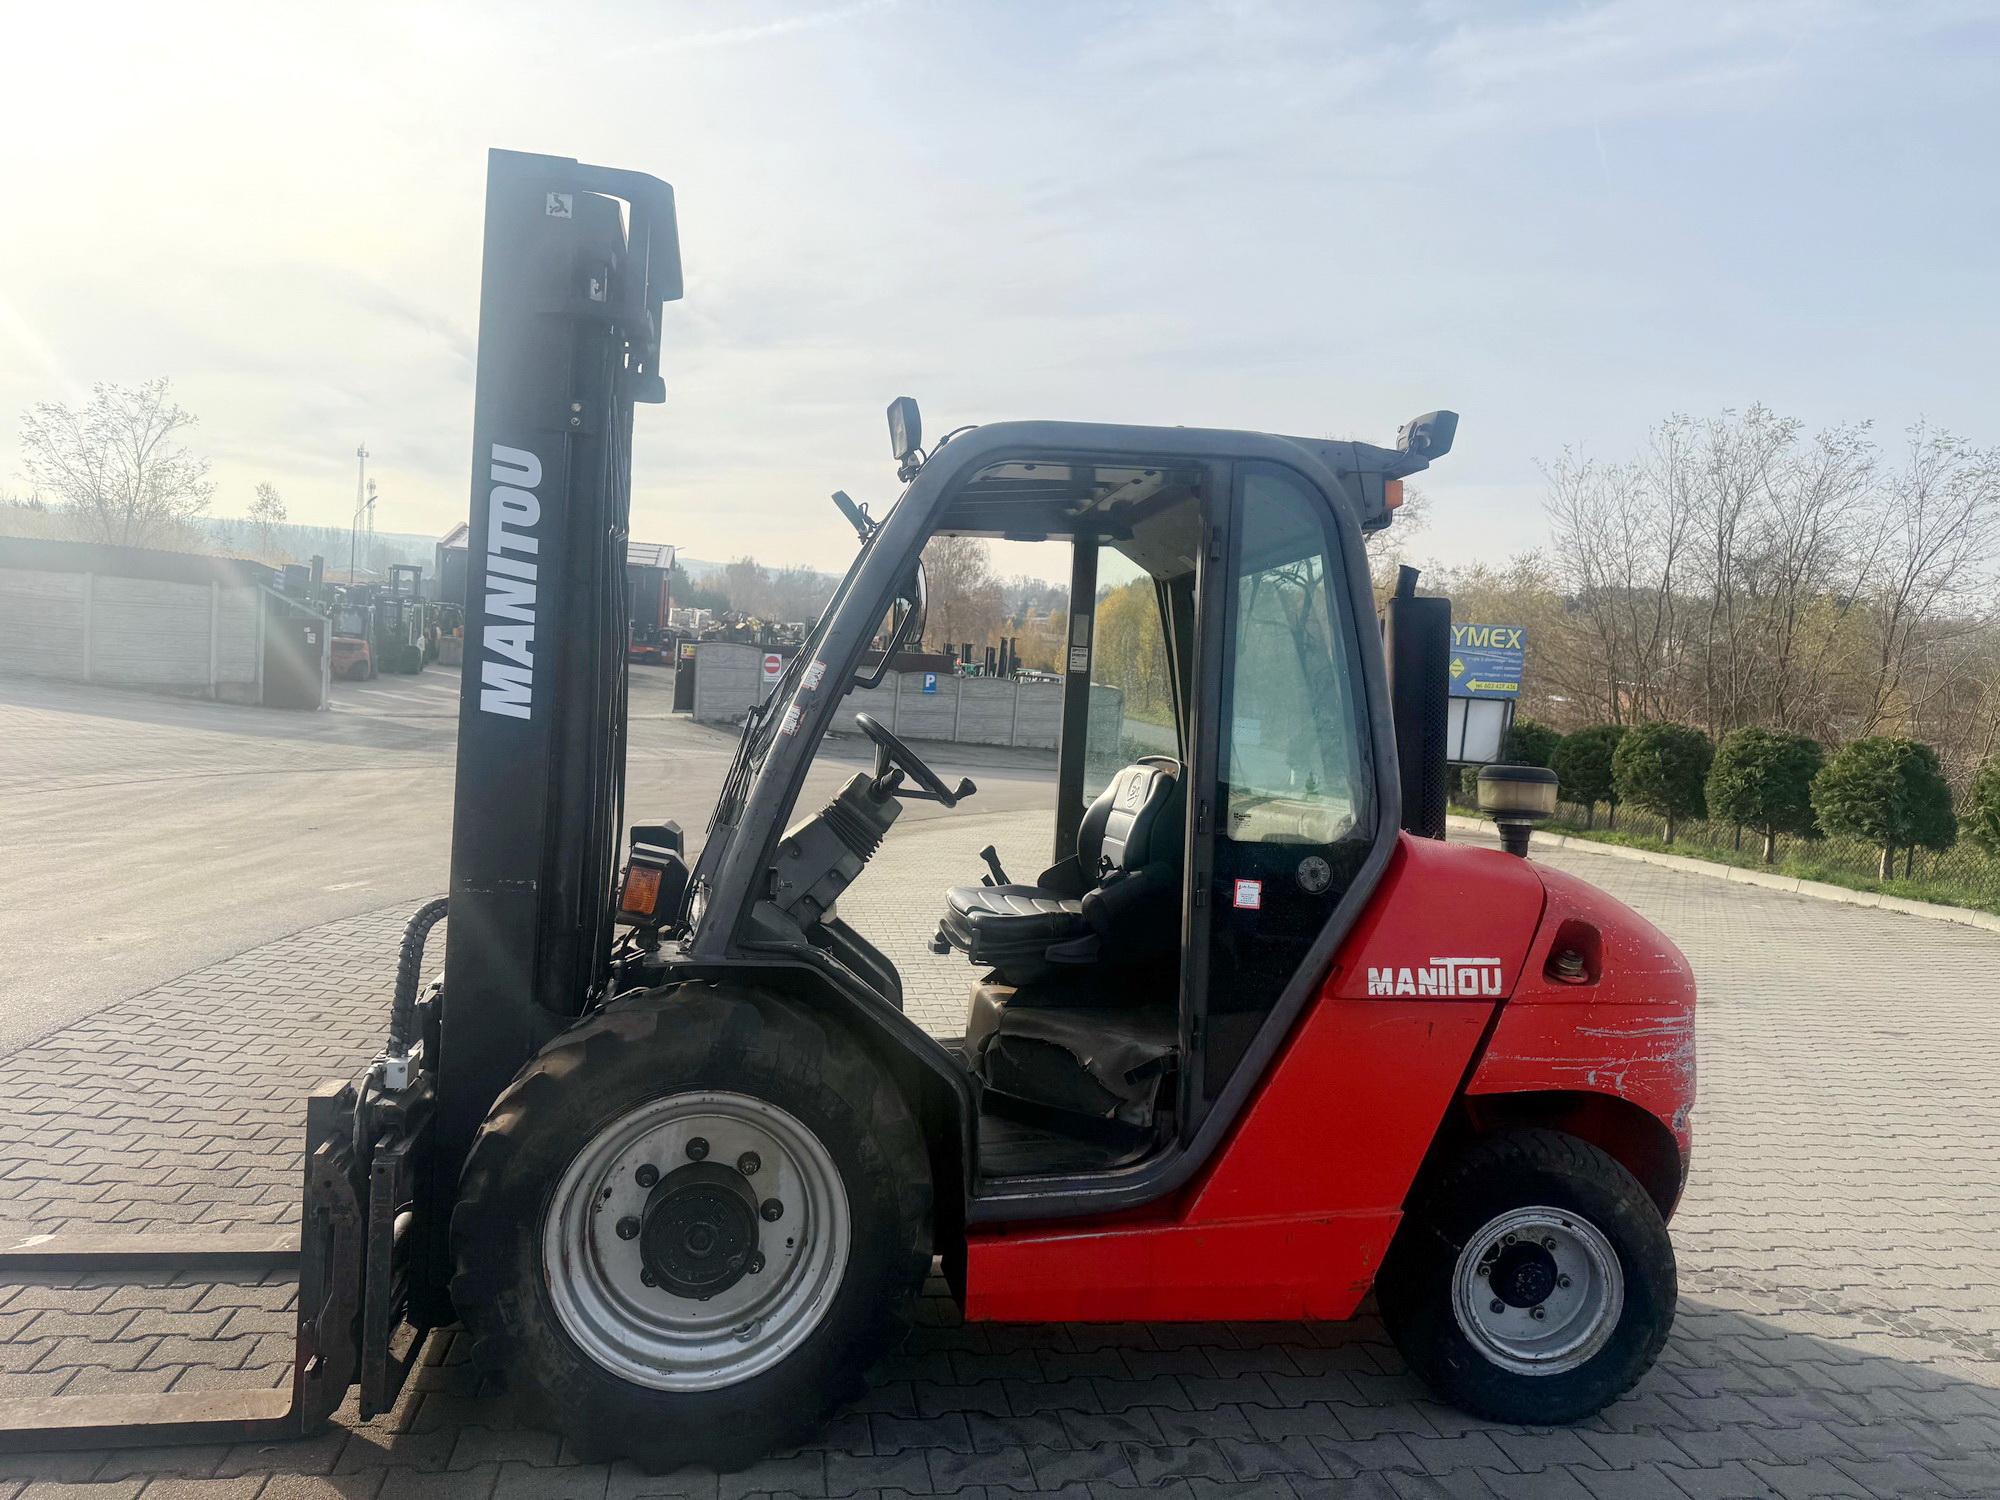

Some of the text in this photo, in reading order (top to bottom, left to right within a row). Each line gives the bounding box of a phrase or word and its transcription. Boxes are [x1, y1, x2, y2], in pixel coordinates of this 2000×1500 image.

[480, 443, 542, 720] MANITOU
[925, 674, 936, 688] P
[1368, 957, 1502, 996] MANITOU
